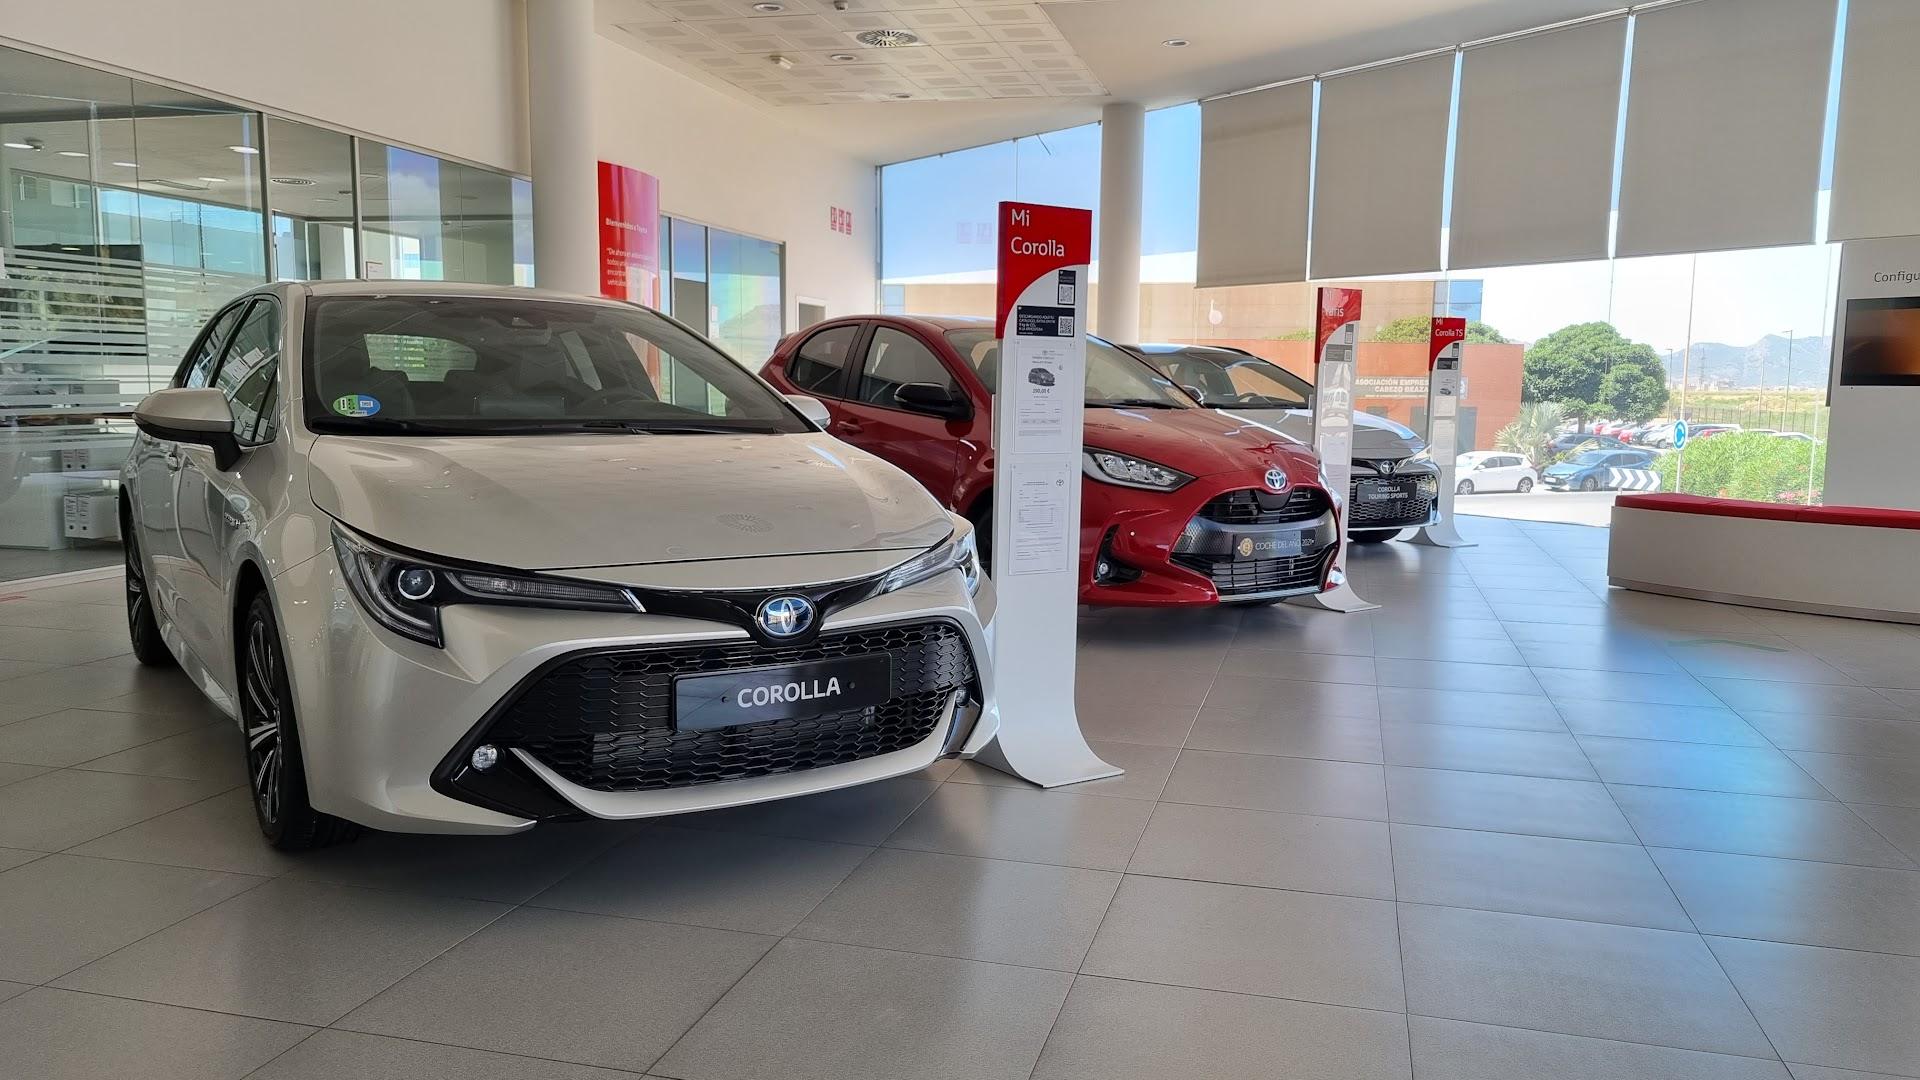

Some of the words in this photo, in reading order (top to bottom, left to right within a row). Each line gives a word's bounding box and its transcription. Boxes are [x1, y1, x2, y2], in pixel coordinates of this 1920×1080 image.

[1011, 208, 1030, 227] Mi
[1011, 236, 1065, 257] Corolla
[1435, 328, 1455, 337] Corolla
[1456, 328, 1464, 337] TS
[1355, 377, 1398, 386] ASOCIACIÓN
[1255, 541, 1276, 550] COCHE
[1277, 540, 1288, 549] DEL
[737, 676, 841, 708] COROLLA
